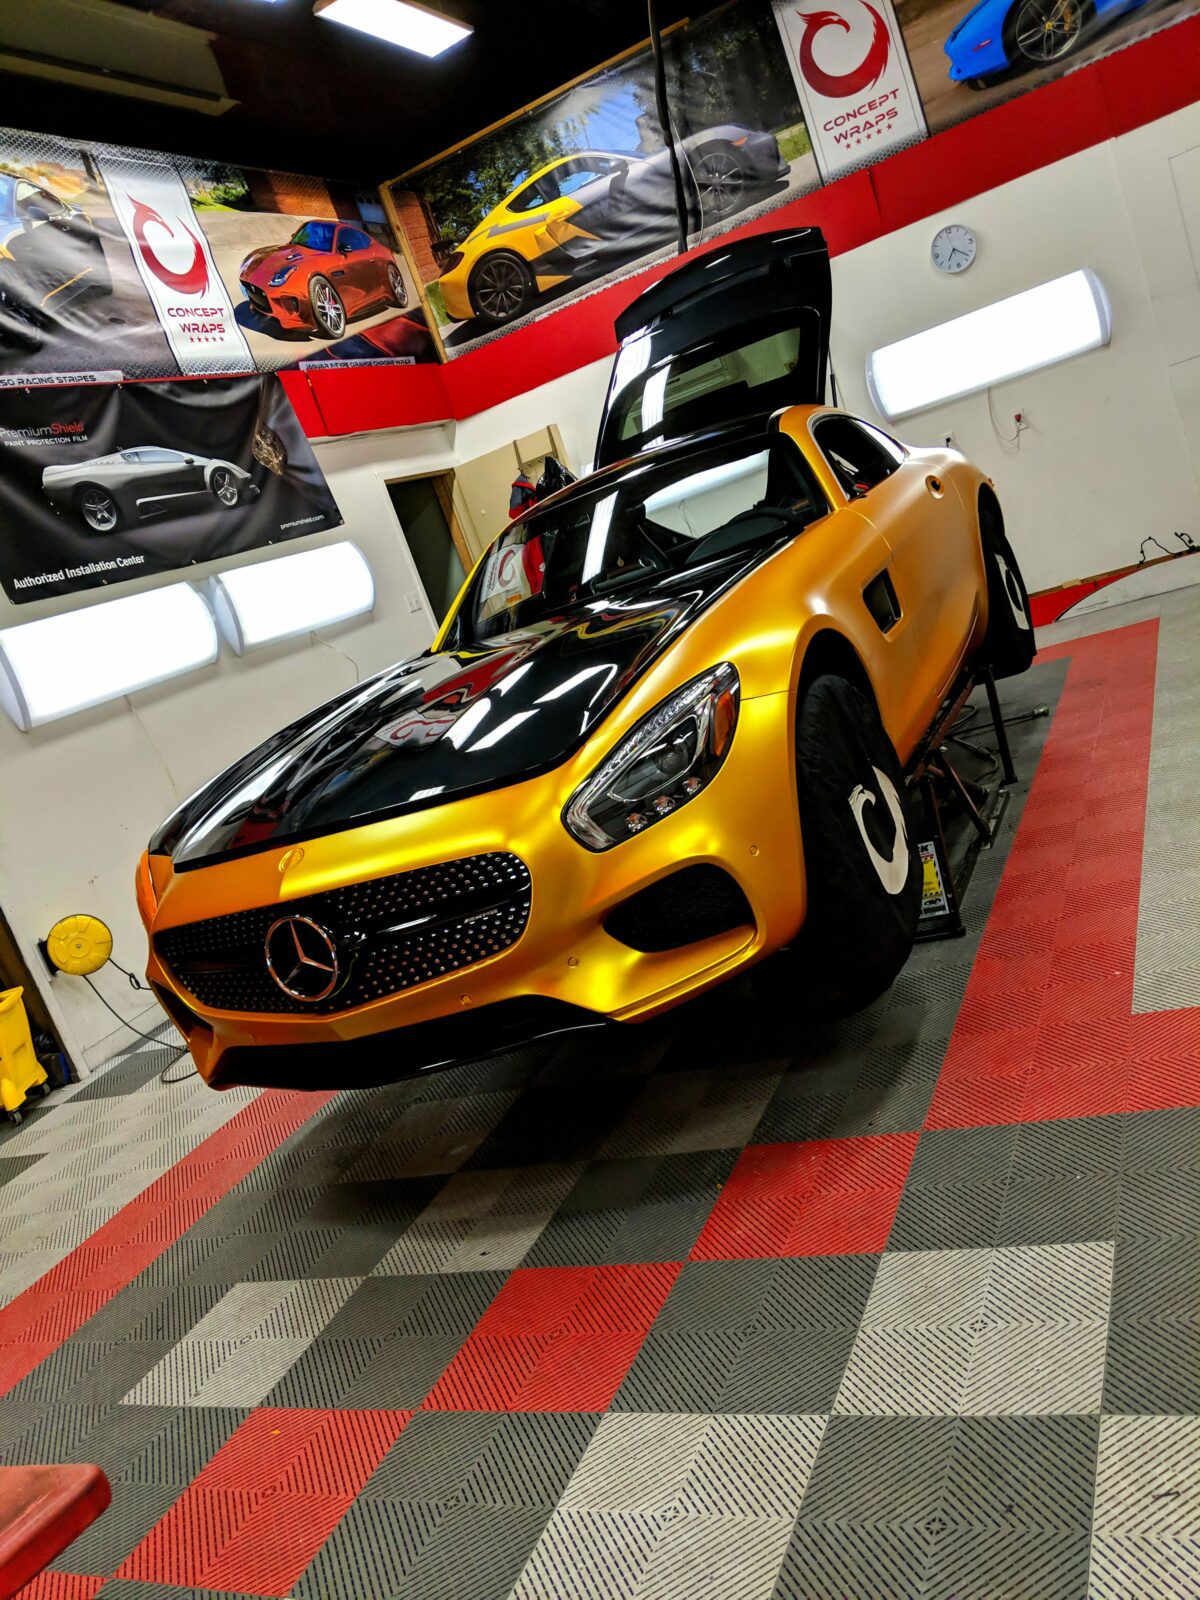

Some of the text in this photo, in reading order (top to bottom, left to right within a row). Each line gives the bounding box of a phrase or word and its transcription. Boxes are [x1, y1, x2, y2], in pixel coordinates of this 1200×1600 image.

[823, 88, 900, 132] CONCEPT
[833, 107, 899, 144] WRAPS
[167, 307, 224, 318] CONCEPT
[179, 322, 226, 334] WRAPS
[17, 376, 56, 386] RACING
[56, 375, 97, 383] STRIPES
[0, 421, 85, 439] PremiumShield
[4, 434, 89, 447] PAINT PROTECTION FILM
[13, 555, 145, 590] Authorized Installation Center
